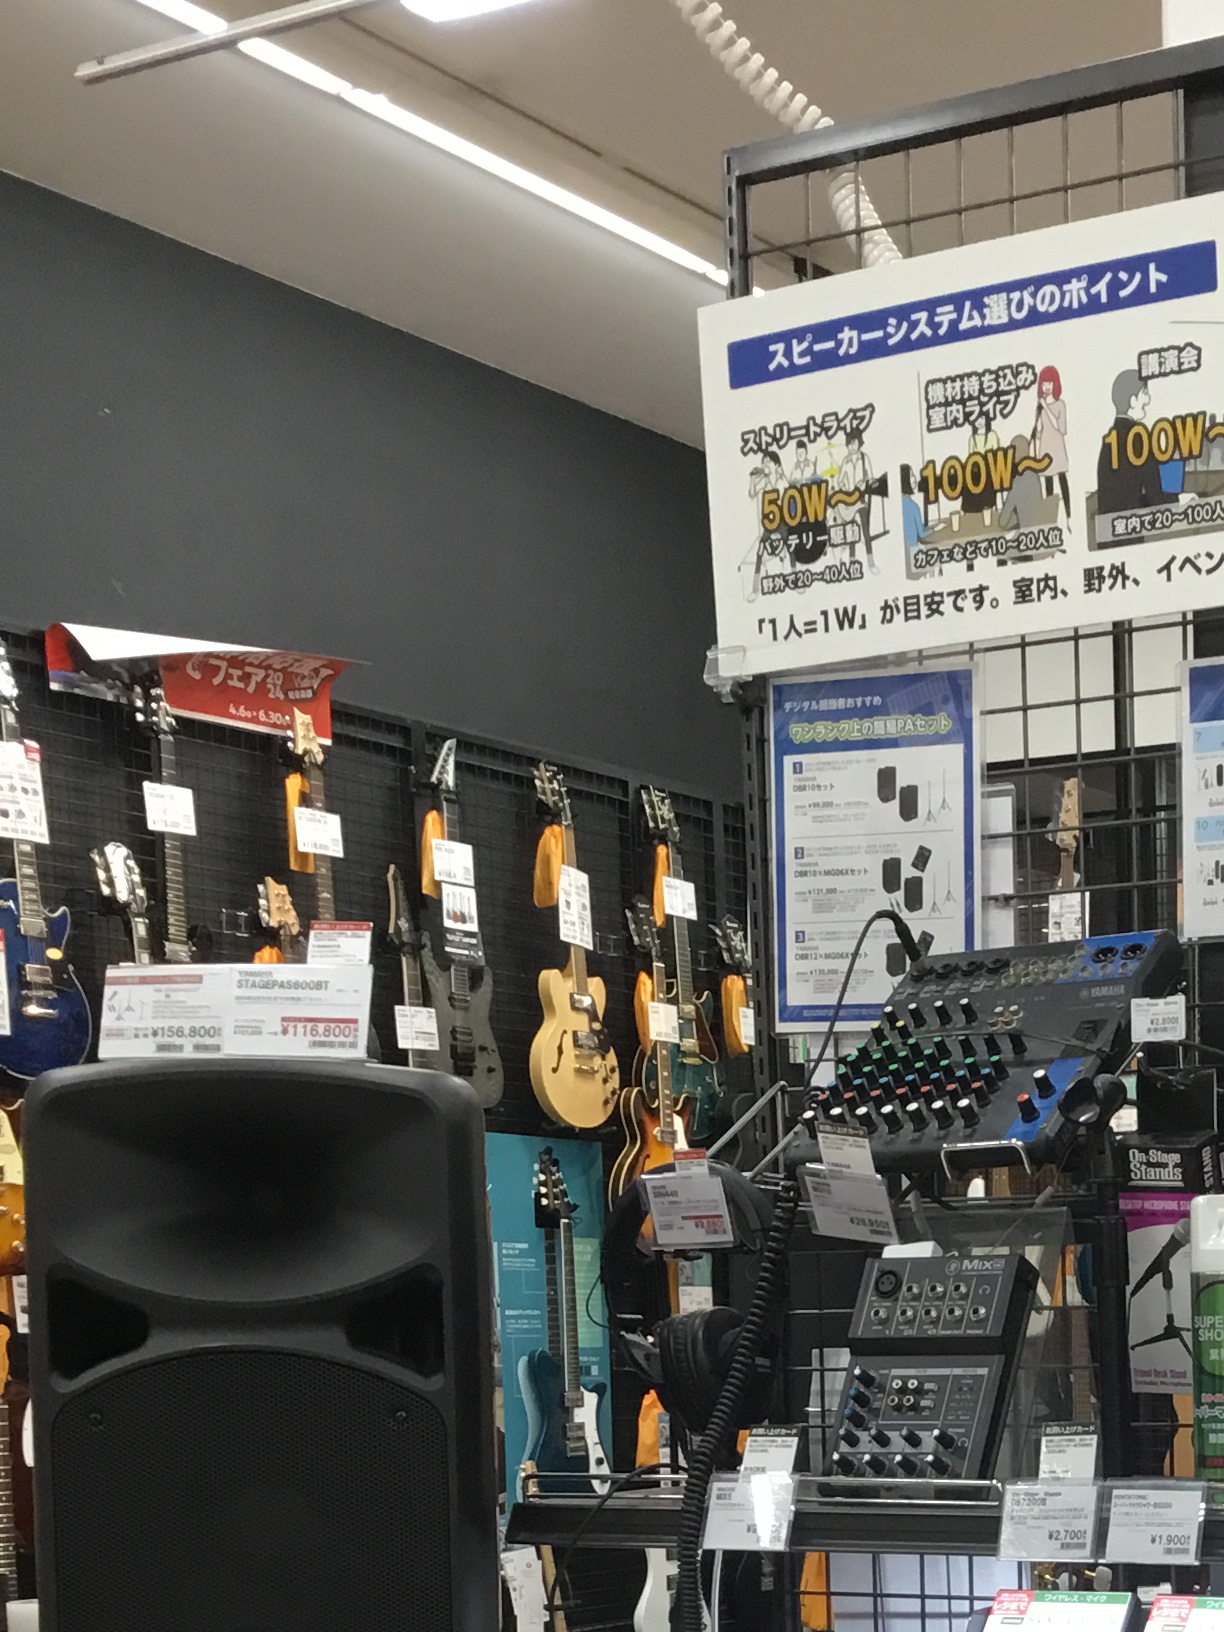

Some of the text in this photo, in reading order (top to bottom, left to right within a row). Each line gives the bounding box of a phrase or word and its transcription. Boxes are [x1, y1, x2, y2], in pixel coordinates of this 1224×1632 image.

[767, 261, 1169, 372] スピーカーシステム選びのポイント
[1139, 343, 1201, 380] 講演会
[926, 364, 1037, 405] 機材持ち込み
[926, 392, 1018, 432] 室内ライブ
[740, 405, 875, 456] ストリートライブ
[757, 525, 861, 557] バッテリー駆動
[207, 658, 267, 694] フェア
[267, 669, 284, 684] 20
[267, 684, 285, 700] 24
[1090, 985, 1125, 997] YAMAHA
[1128, 1149, 1181, 1165] On-Stage
[1130, 1162, 1183, 1181] Stands
[1202, 1145, 1215, 1188] STAND
[992, 1602, 1028, 1611] レジまで
[1043, 1593, 1107, 1603] ワイヤレス・マイク
